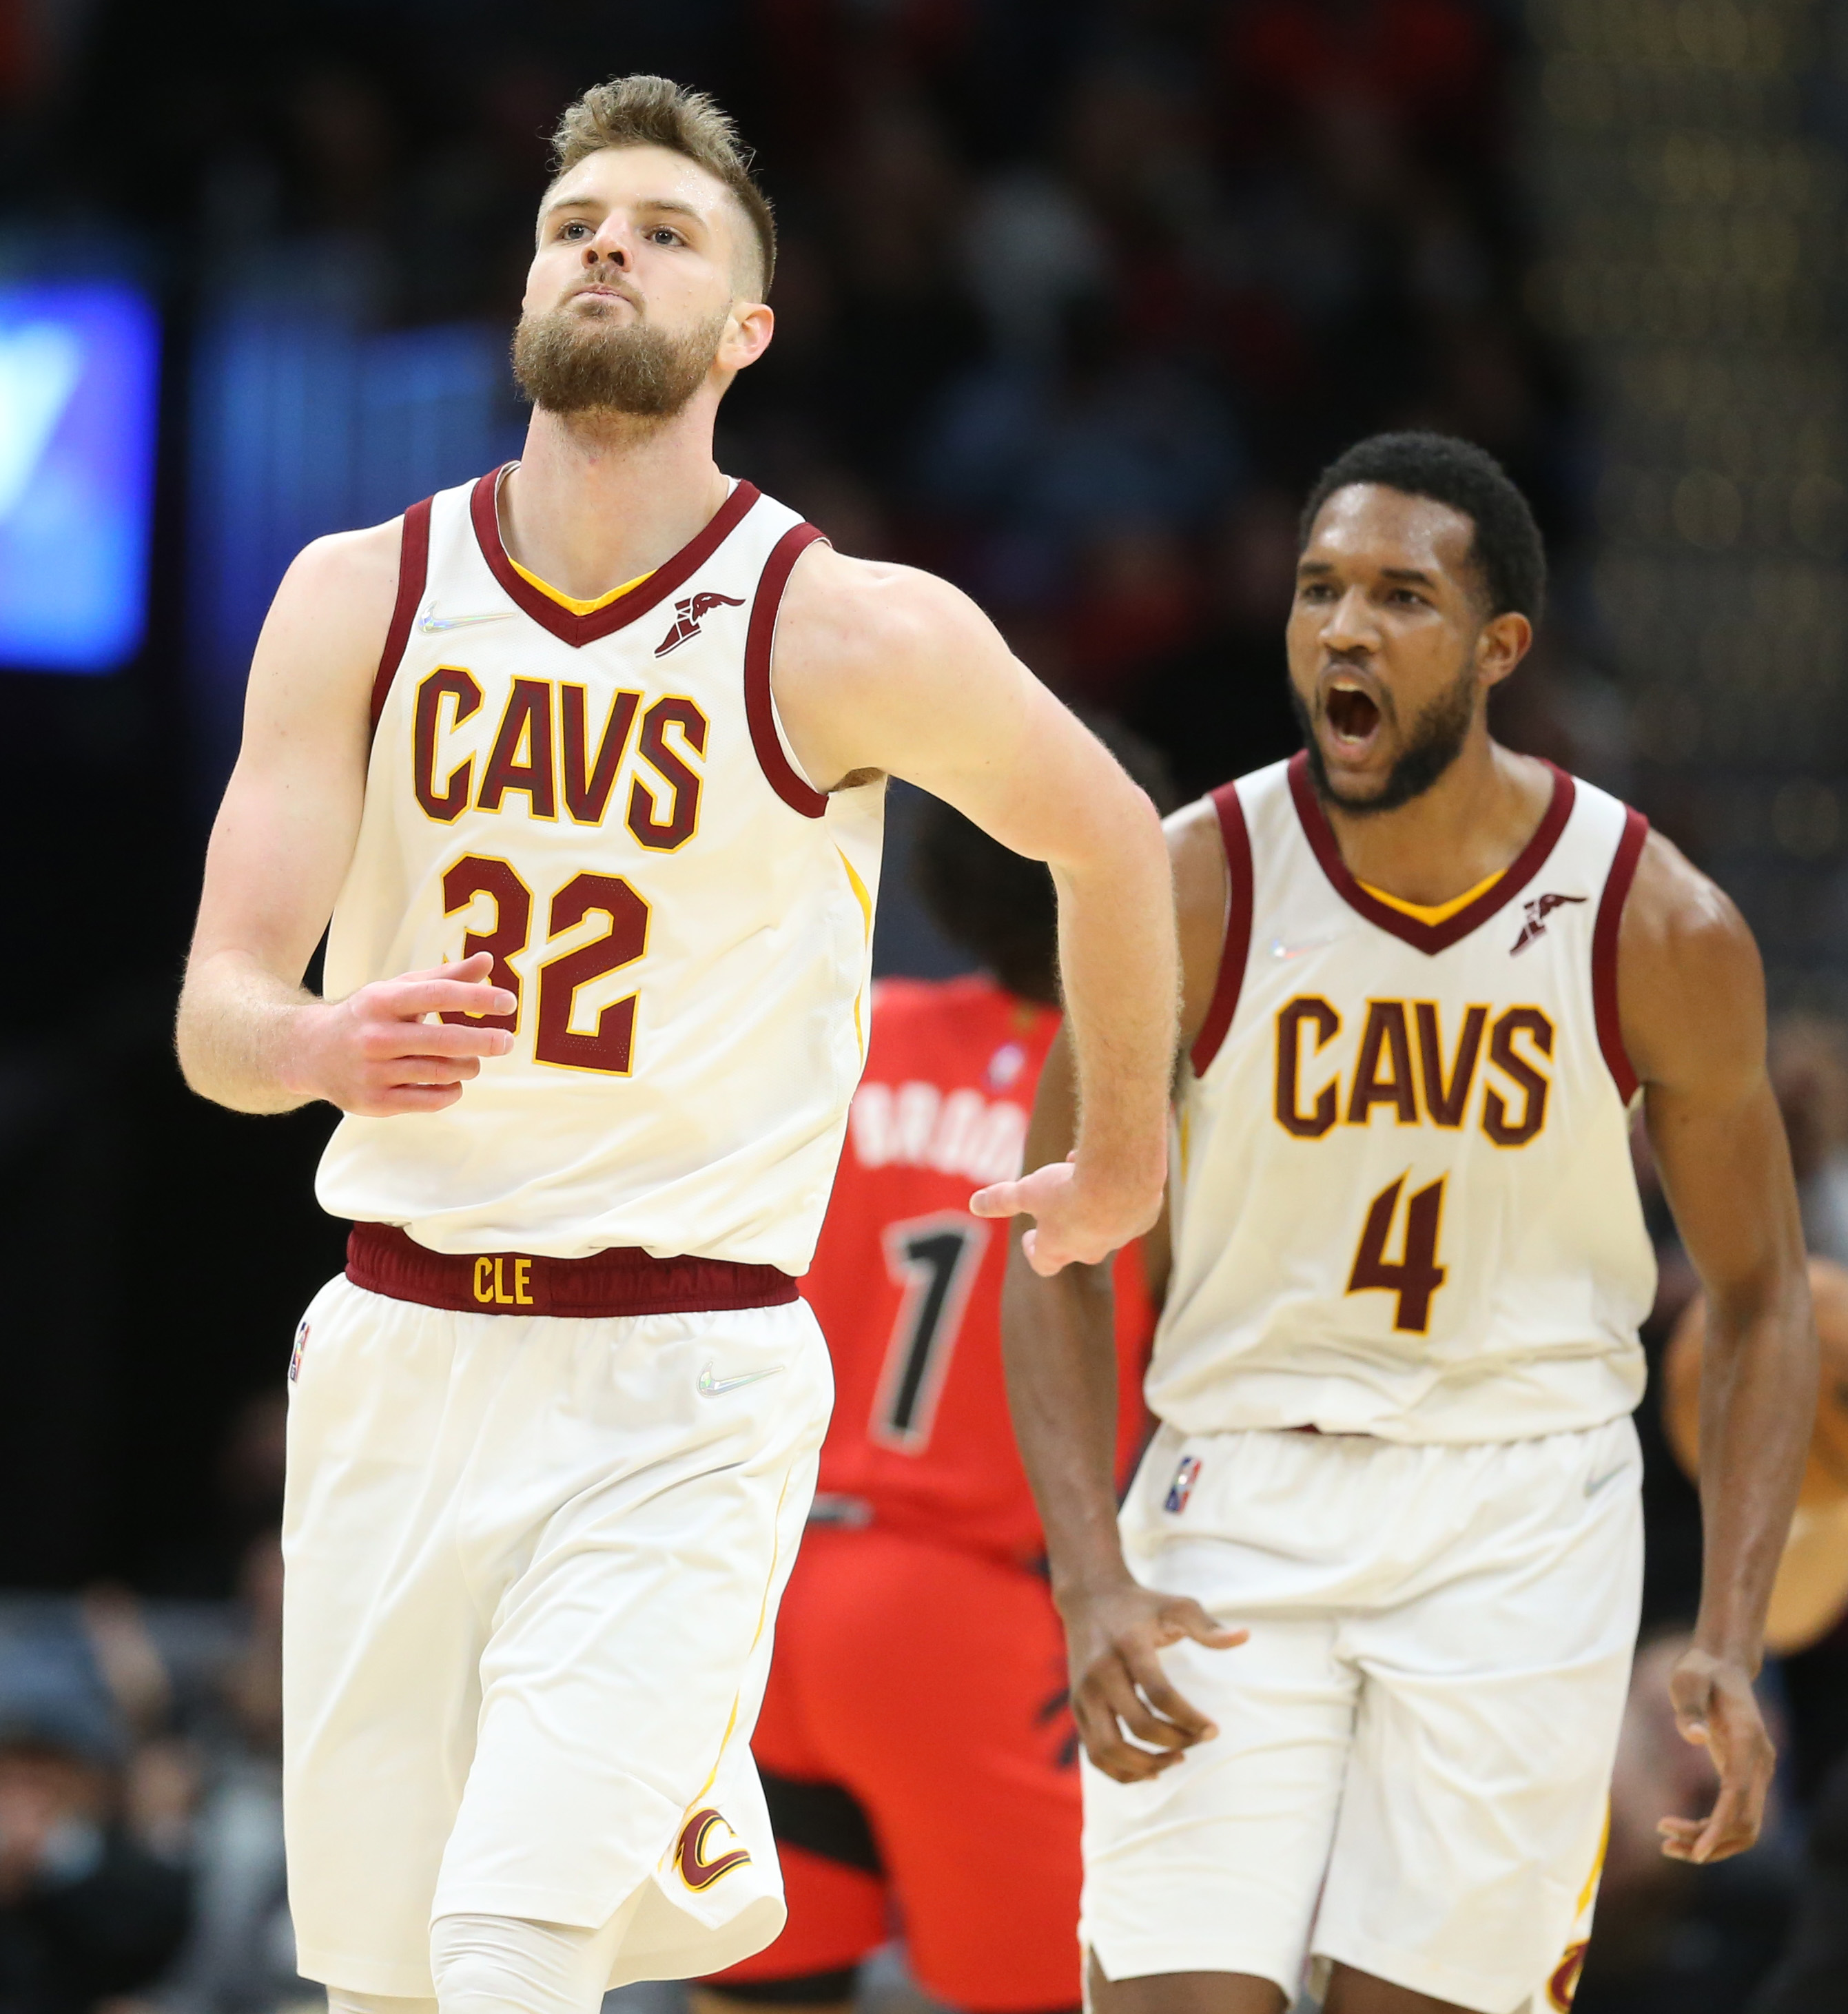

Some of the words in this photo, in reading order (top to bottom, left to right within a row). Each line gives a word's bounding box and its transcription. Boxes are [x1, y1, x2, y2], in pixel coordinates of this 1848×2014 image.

[413, 665, 710, 854] CAVS
[435, 852, 653, 1077] 32
[1274, 993, 1555, 1149] CAVS
[473, 1257, 534, 1304] CLE
[866, 1209, 993, 1457] 1
[1344, 1164, 1450, 1336] 4
